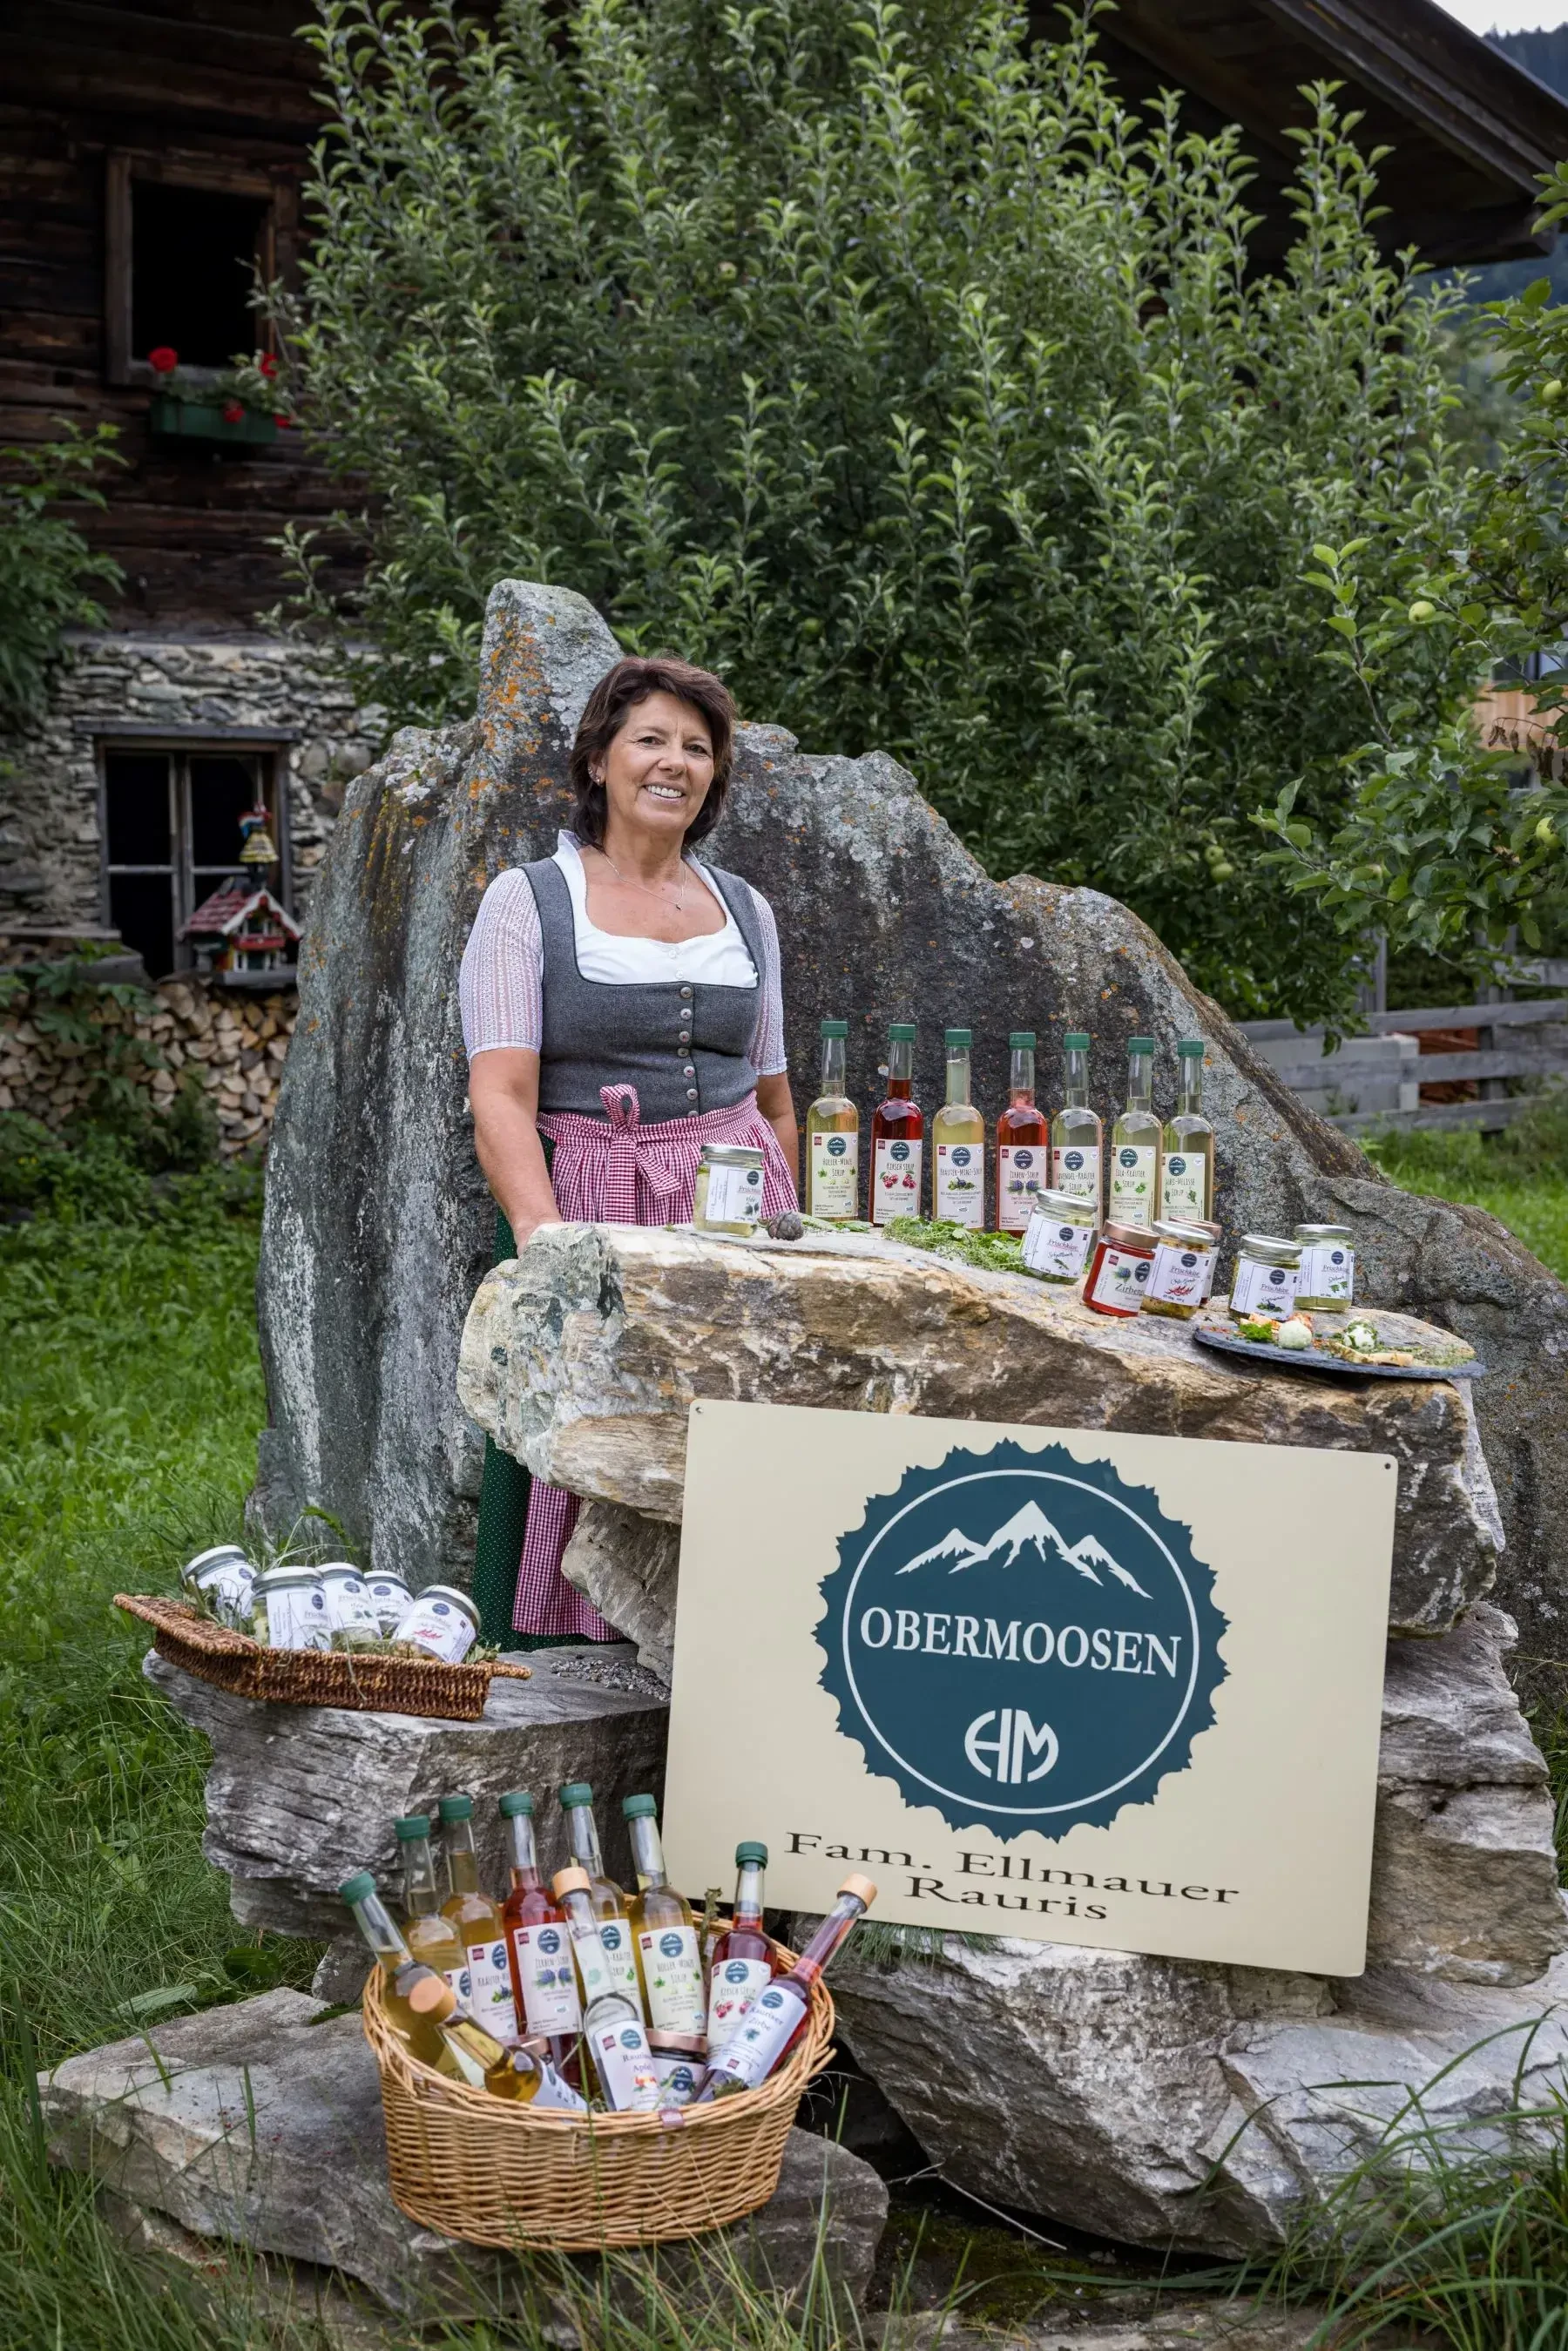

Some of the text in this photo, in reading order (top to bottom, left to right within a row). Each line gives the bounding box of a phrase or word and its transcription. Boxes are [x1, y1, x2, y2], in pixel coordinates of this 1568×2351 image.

[860, 1606, 1182, 1679] OBERMOOSEN
[785, 1832, 1240, 1904] Fam. Ellmauer
[904, 1875, 1107, 1921] Rauris
